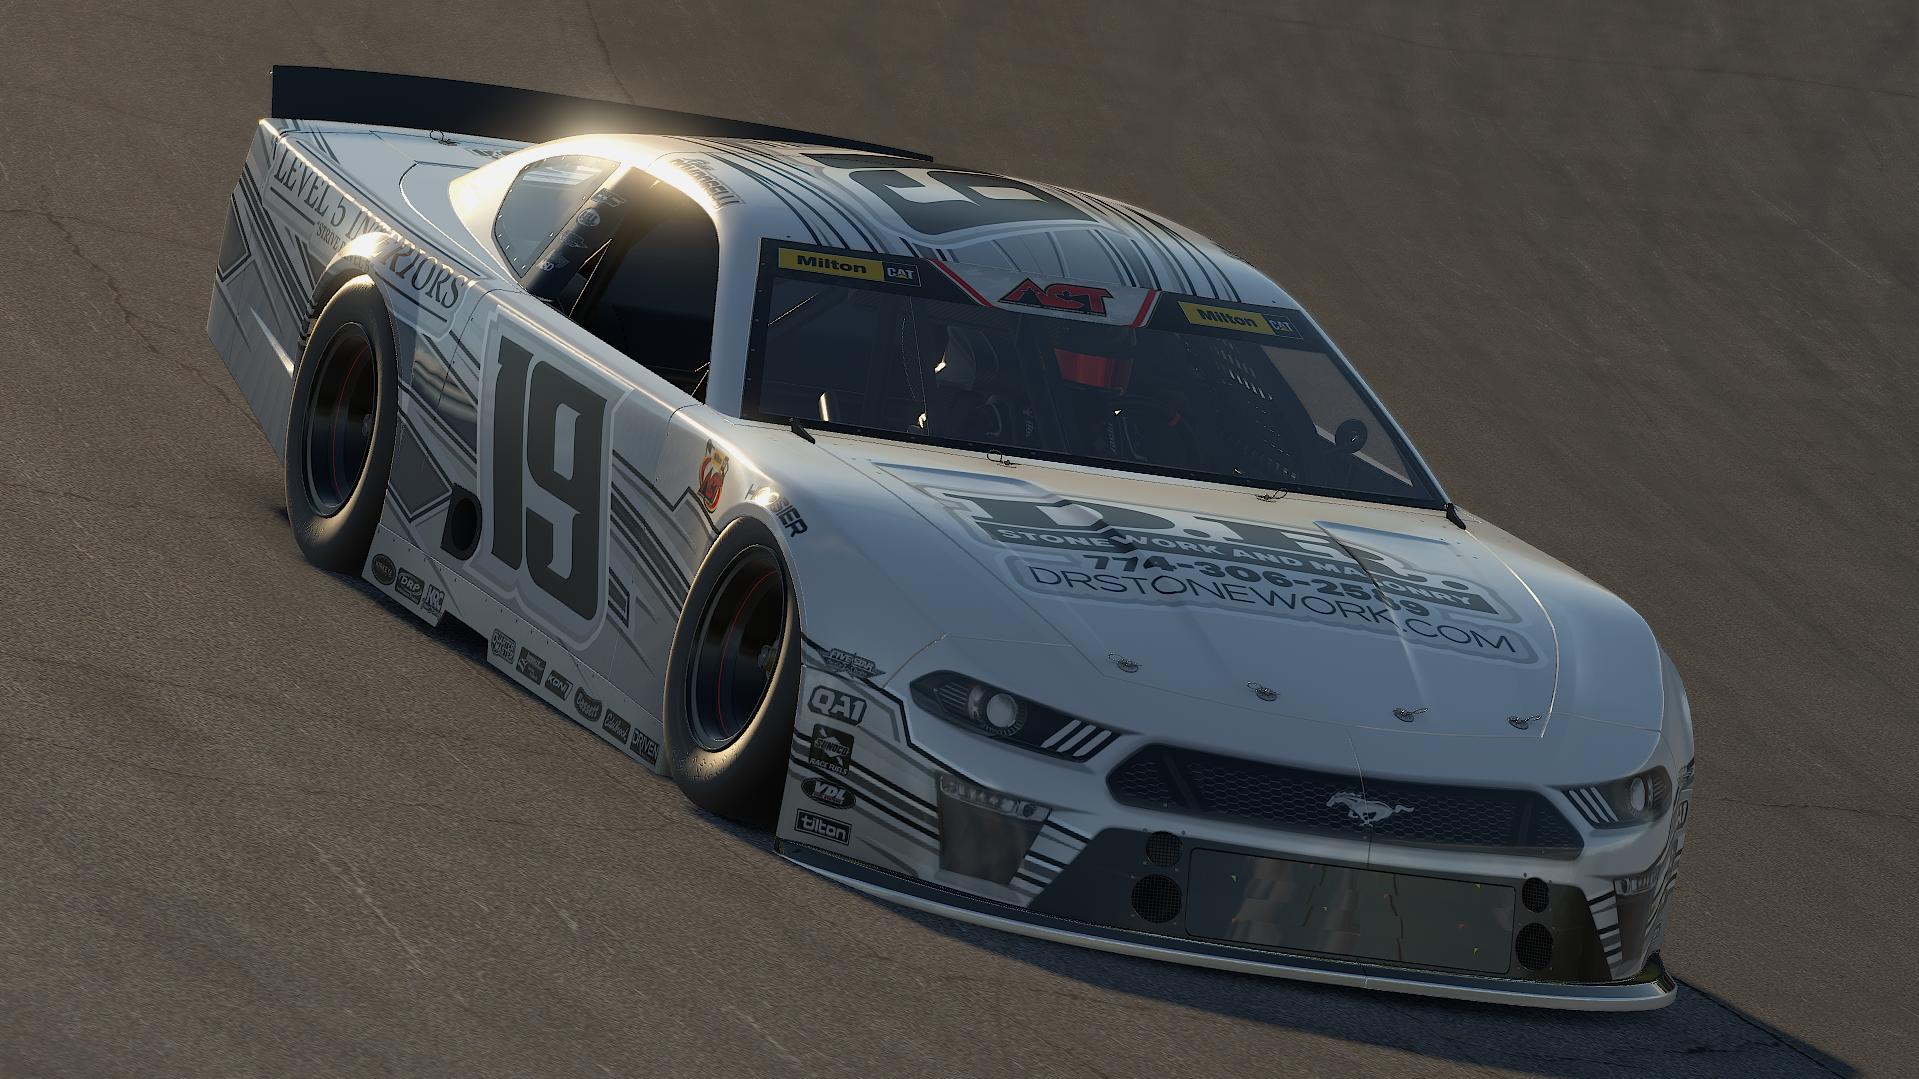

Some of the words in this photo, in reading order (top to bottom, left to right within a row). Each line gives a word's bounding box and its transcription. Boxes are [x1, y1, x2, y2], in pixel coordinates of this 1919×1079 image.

[274, 148, 329, 217] LEVEL
[330, 196, 347, 228] 5
[345, 206, 467, 309] INRIORS
[797, 255, 867, 274] Milton
[887, 267, 914, 280] CAT
[1197, 309, 1258, 328] Milton
[1269, 319, 1293, 332] CAT
[491, 335, 608, 621] 19
[997, 529, 1218, 555] STONEWORK
[1233, 549, 1305, 567] AND
[401, 576, 421, 592] DRP
[1028, 565, 1517, 653] DRSTONEWORK.COM
[548, 676, 568, 692] KONI
[811, 688, 865, 722] QA1
[633, 730, 659, 758] DRIVEN
[813, 737, 850, 757] SUNOCO
[809, 758, 829, 769] RACE
[829, 763, 848, 775] FUELS
[801, 814, 847, 841] tilton
